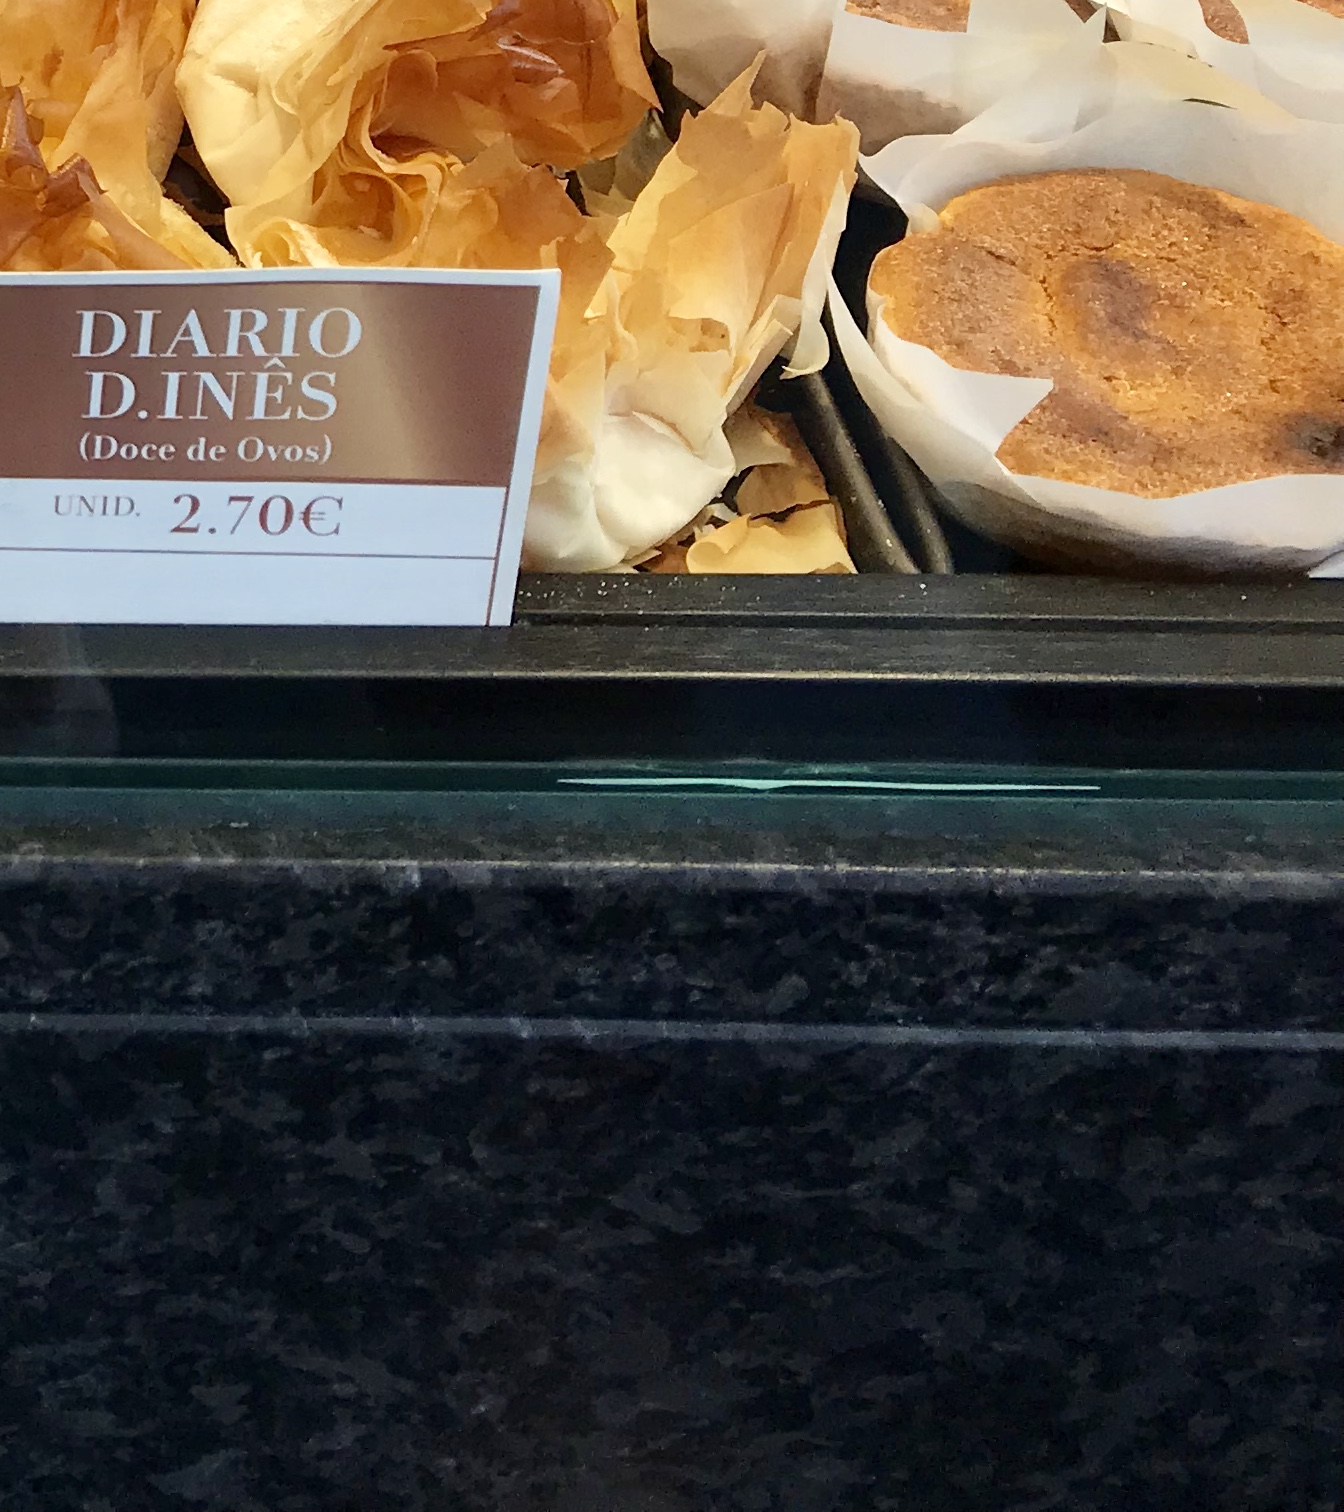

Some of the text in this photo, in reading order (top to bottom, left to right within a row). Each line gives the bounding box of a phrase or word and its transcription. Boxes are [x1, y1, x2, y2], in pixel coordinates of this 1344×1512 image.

[71, 306, 363, 359] DIARIO
[80, 356, 339, 422] D.INÊS
[78, 432, 333, 465] (Doce de Ovos)
[53, 493, 344, 537] UNID. 2.70€
